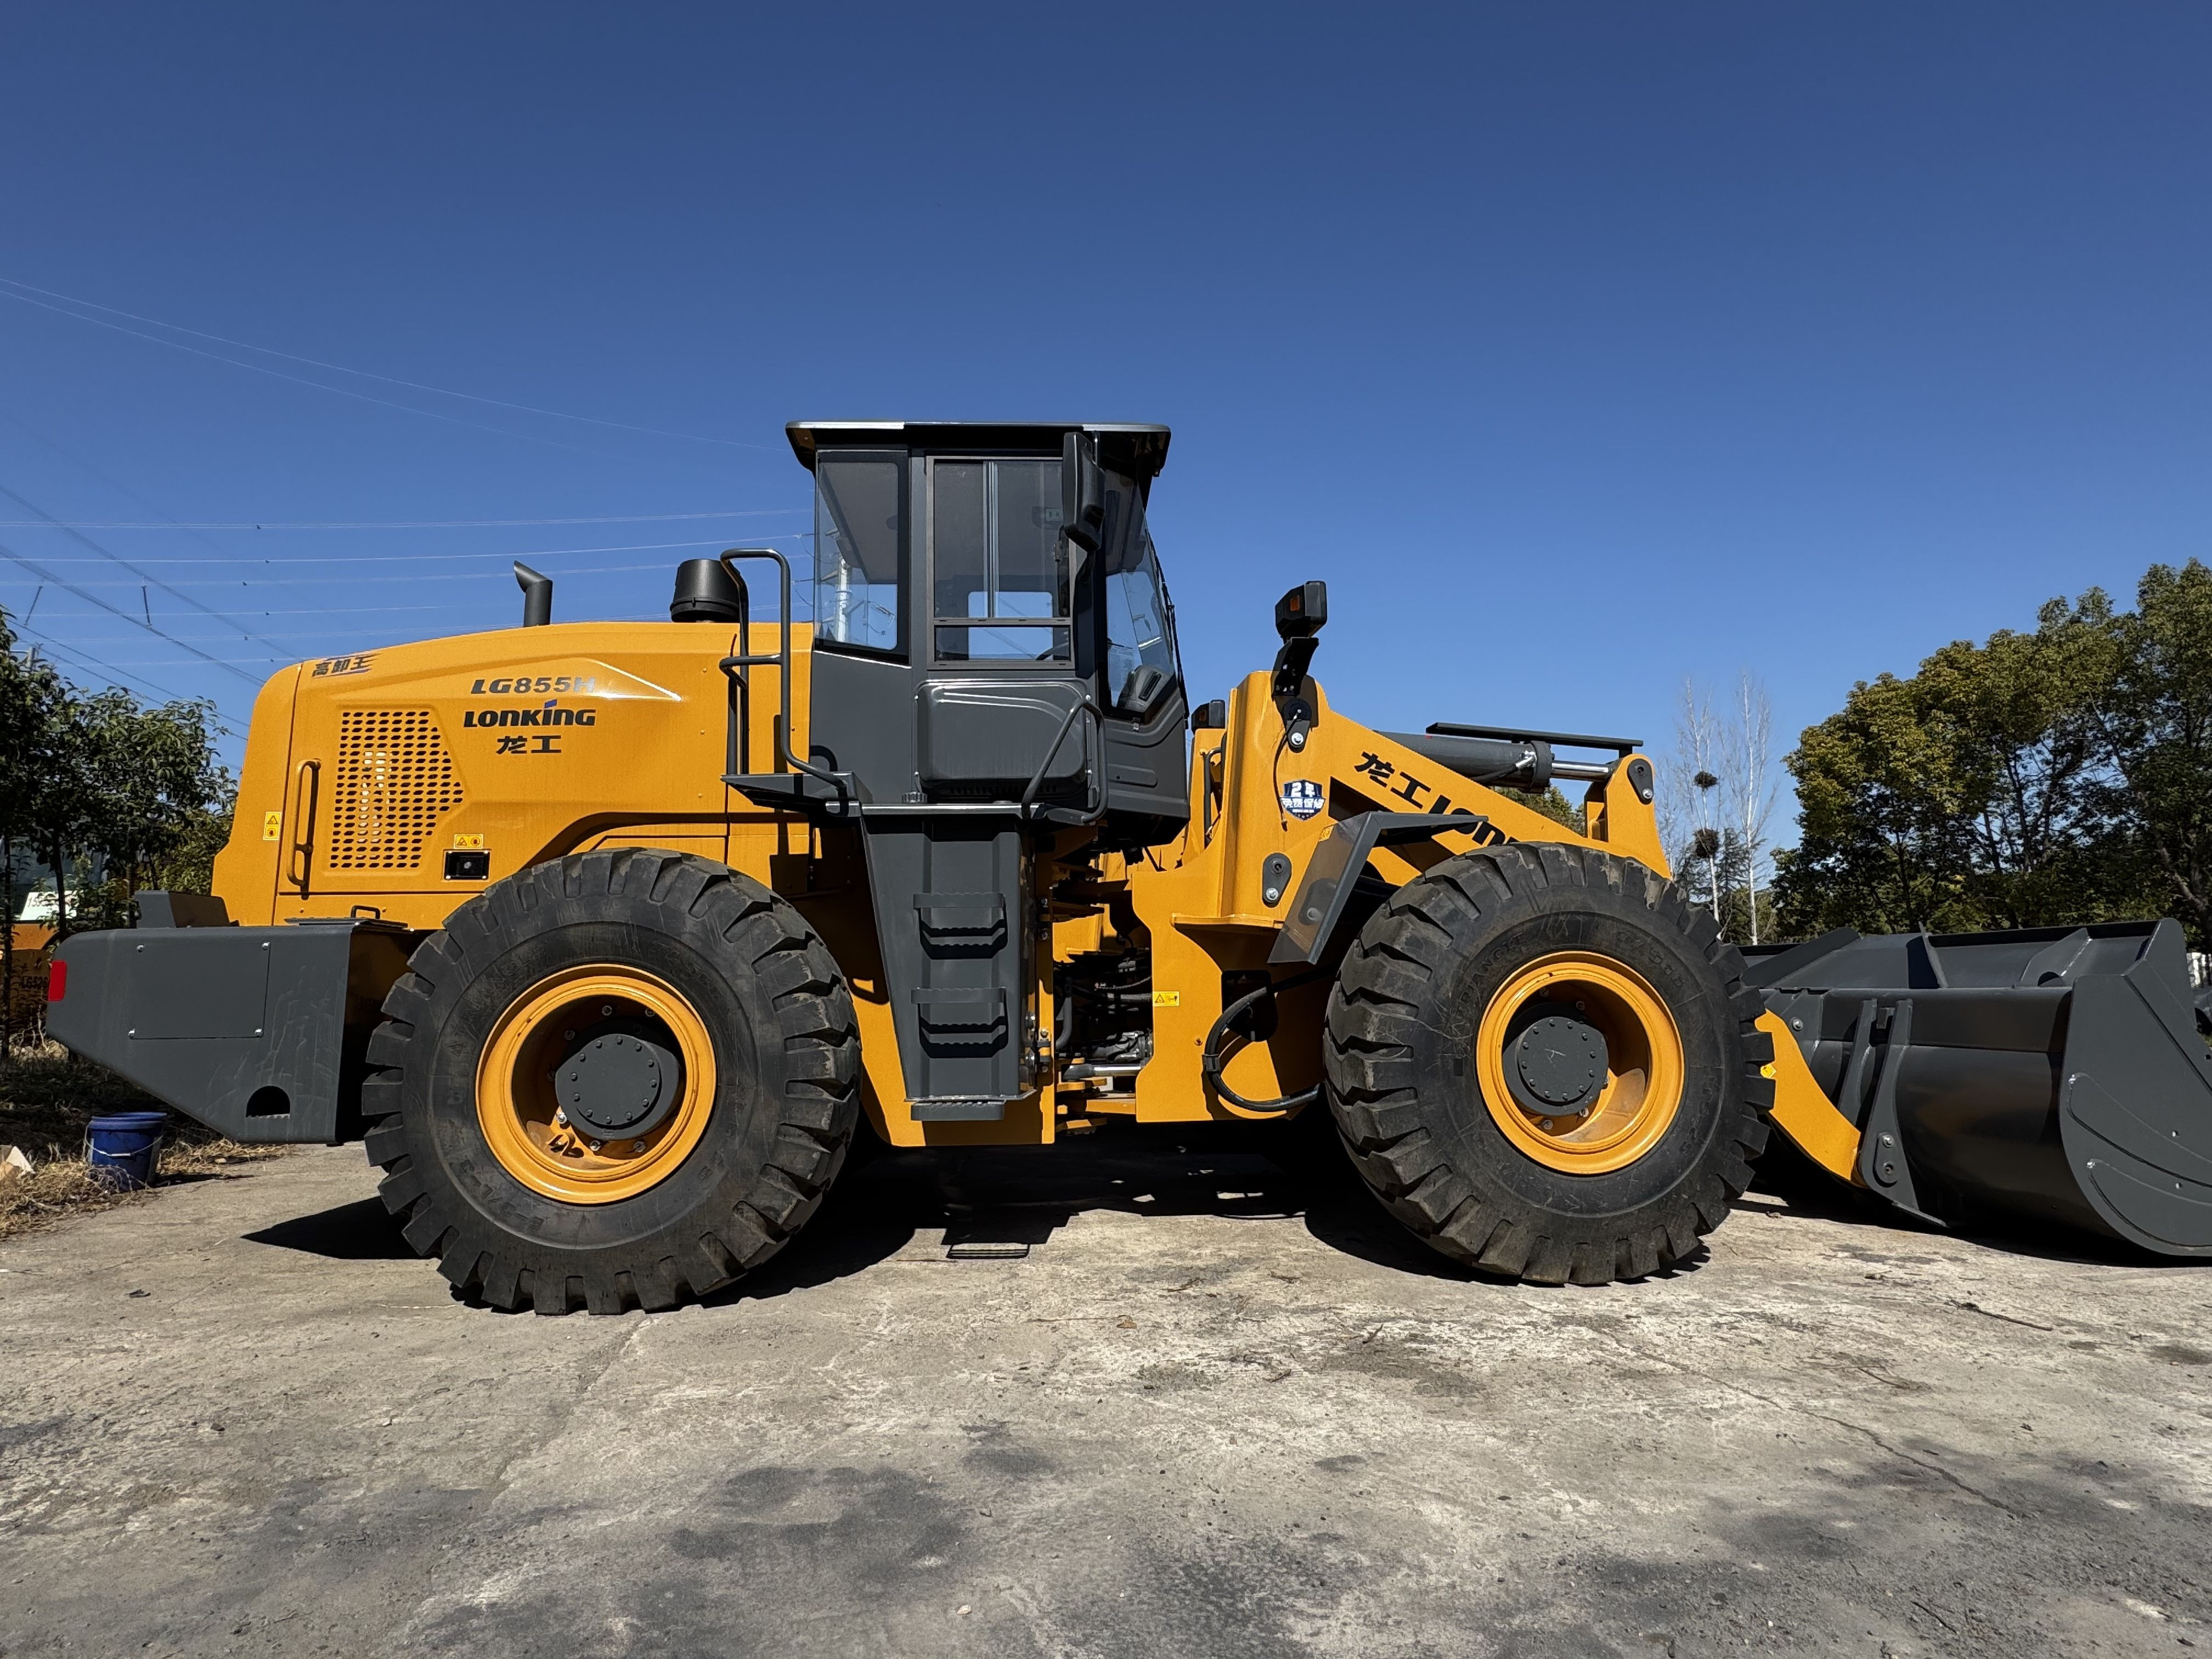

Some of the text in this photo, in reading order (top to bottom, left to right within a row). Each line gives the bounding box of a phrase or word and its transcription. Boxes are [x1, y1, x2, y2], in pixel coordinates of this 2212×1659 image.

[471, 676, 595, 695] LG855H
[496, 735, 561, 754] 龙工
[1291, 782, 1316, 797] 2年
[1354, 751, 1432, 809] 龙工
[1281, 798, 1324, 809] 免费保修
